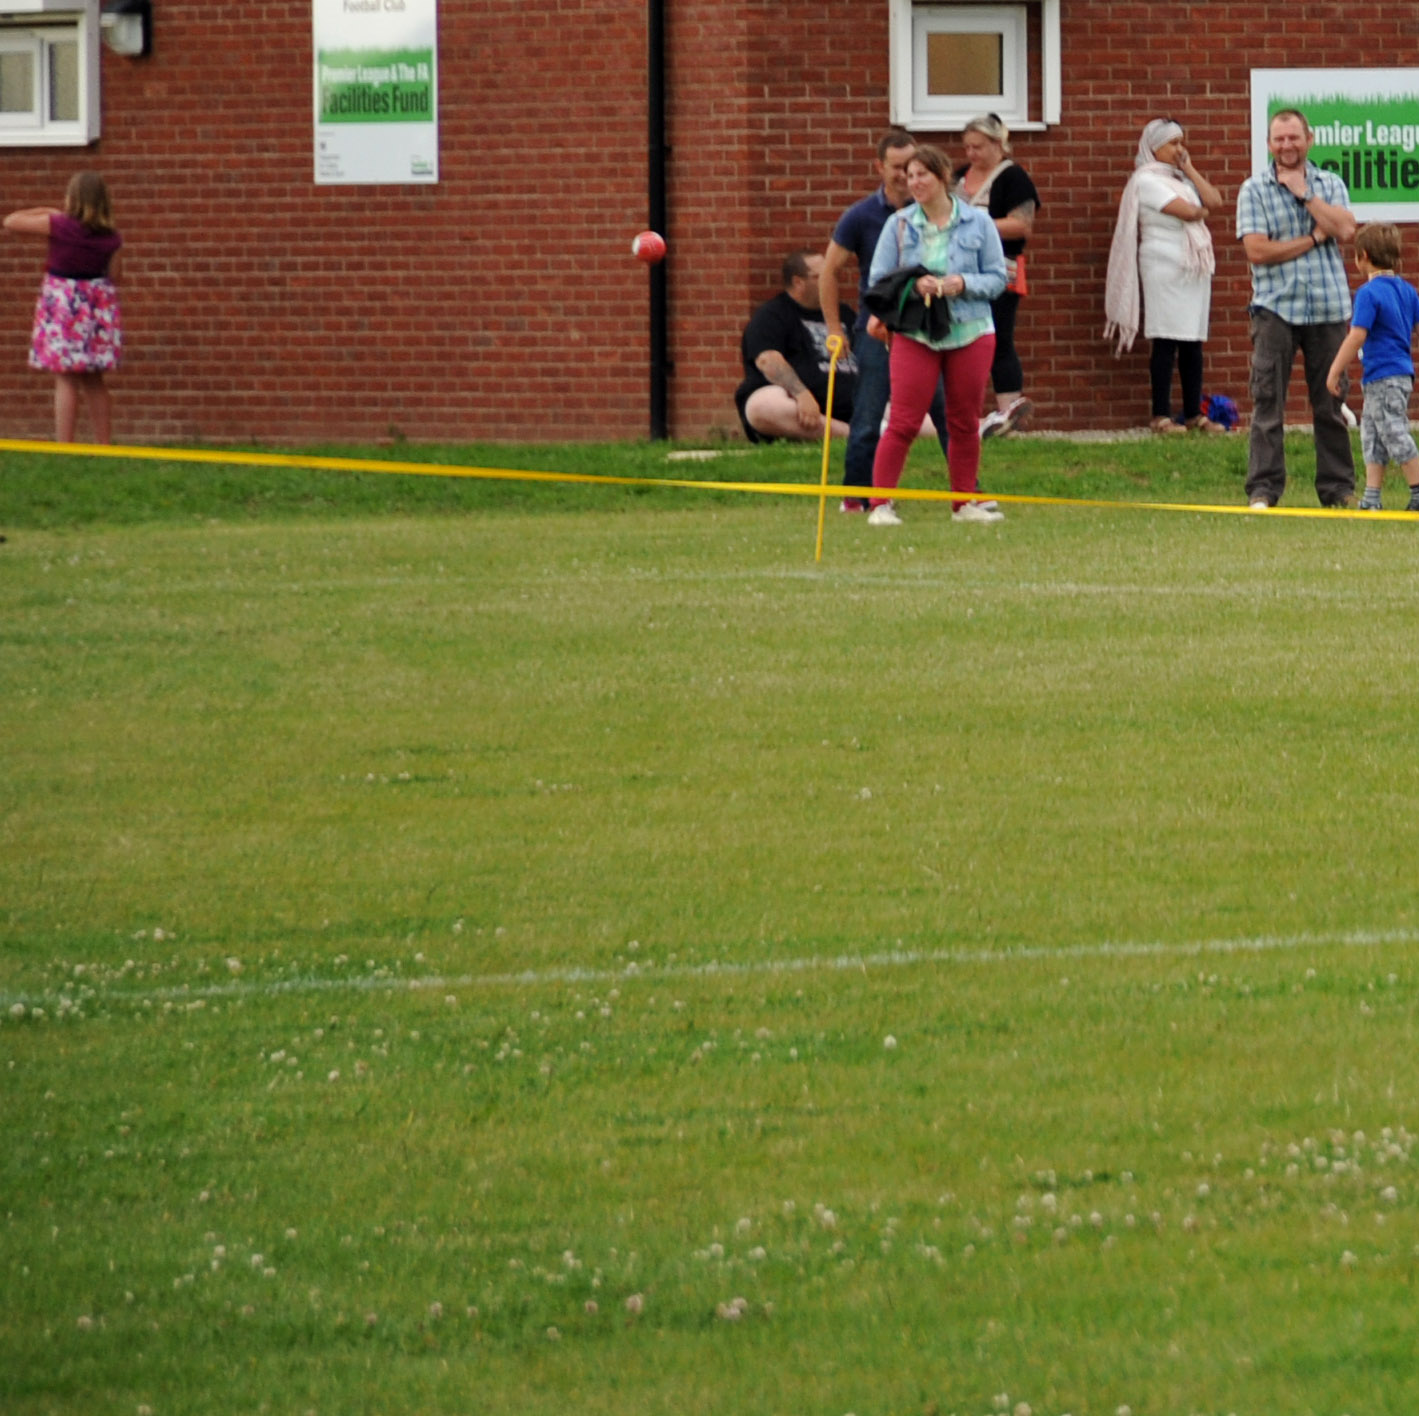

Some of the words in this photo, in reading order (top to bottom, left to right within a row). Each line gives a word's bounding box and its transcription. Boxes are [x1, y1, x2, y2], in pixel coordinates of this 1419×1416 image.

[357, 64, 390, 88] League
[398, 62, 416, 81] The
[417, 62, 429, 81] FA
[392, 84, 428, 113] Fund
